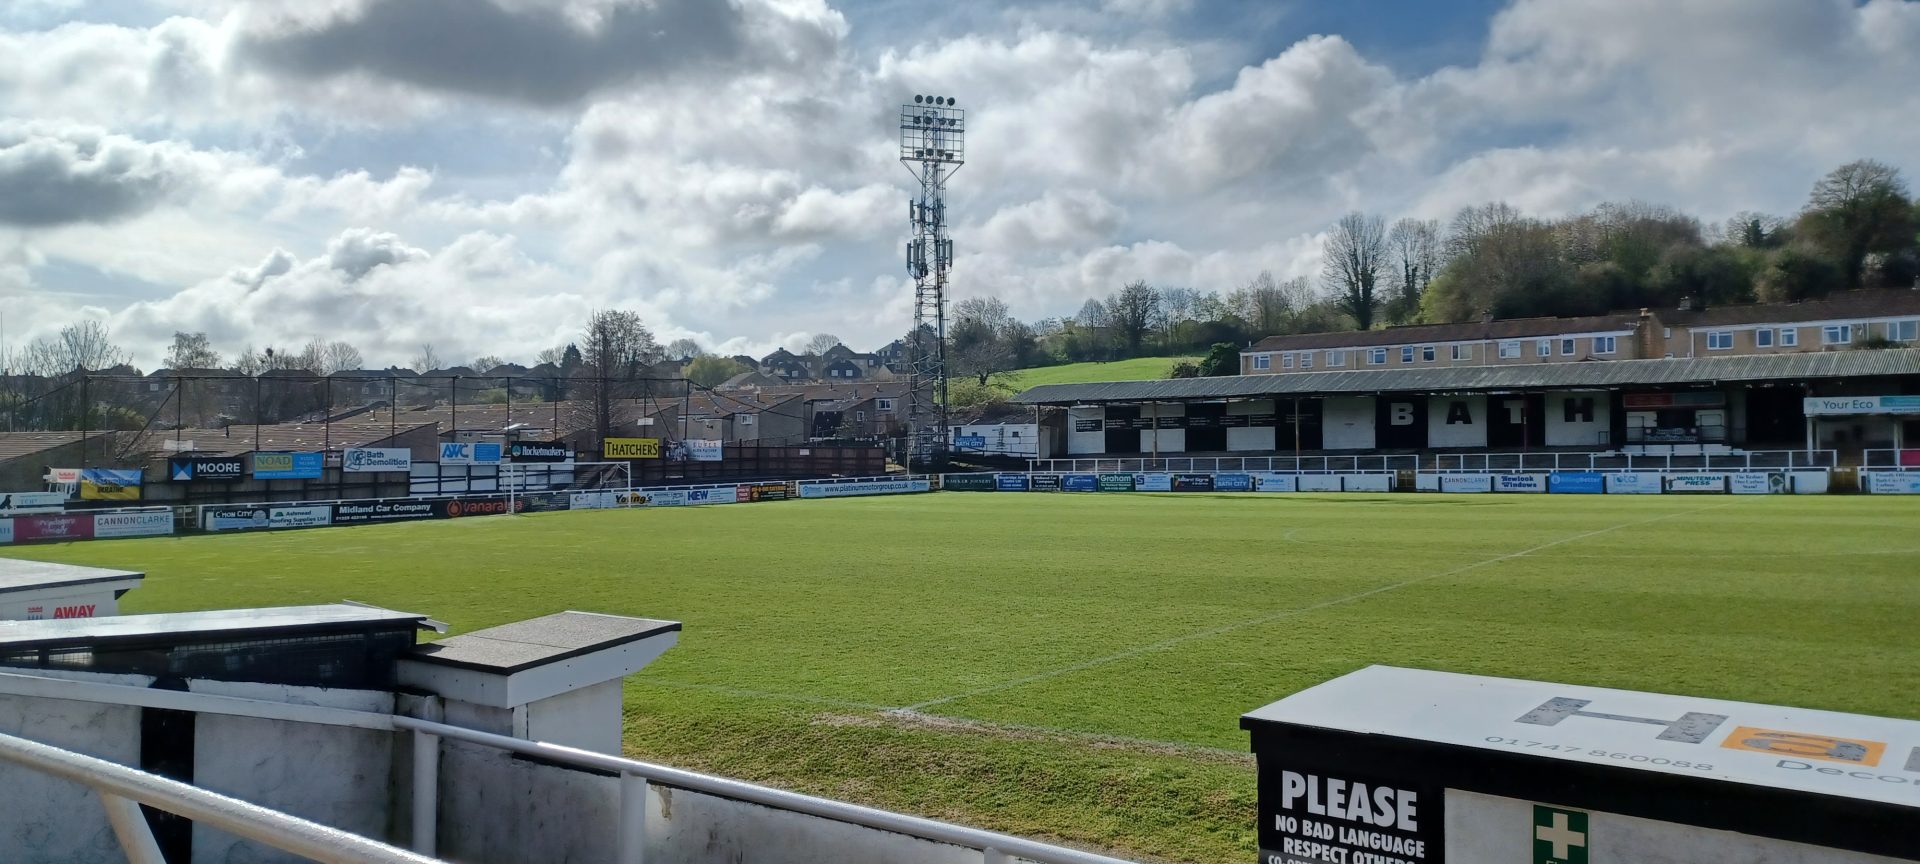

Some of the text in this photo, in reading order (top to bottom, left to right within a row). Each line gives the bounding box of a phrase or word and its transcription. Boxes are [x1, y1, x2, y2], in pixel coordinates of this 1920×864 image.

[1824, 399, 1873, 409] Your Eco
[442, 443, 469, 458] AWC
[522, 446, 565, 456] Rocketmakers
[606, 441, 658, 456] THATCHERS
[257, 456, 290, 465] NOAD
[367, 458, 408, 466] Demolition
[197, 463, 241, 472] MOORE
[687, 491, 709, 501] KEW
[339, 506, 374, 514] Midland
[393, 504, 431, 512] Company
[97, 515, 170, 526] CANNONCLARKE
[53, 605, 96, 619] AWAY
[1485, 736, 1714, 771] 01747 860088
[1776, 759, 1920, 785] Deco
[1282, 770, 1417, 832] PLEASE
[1275, 814, 1425, 858] NO BAD LANGUAGE
[1283, 836, 1348, 864] RESPECT
